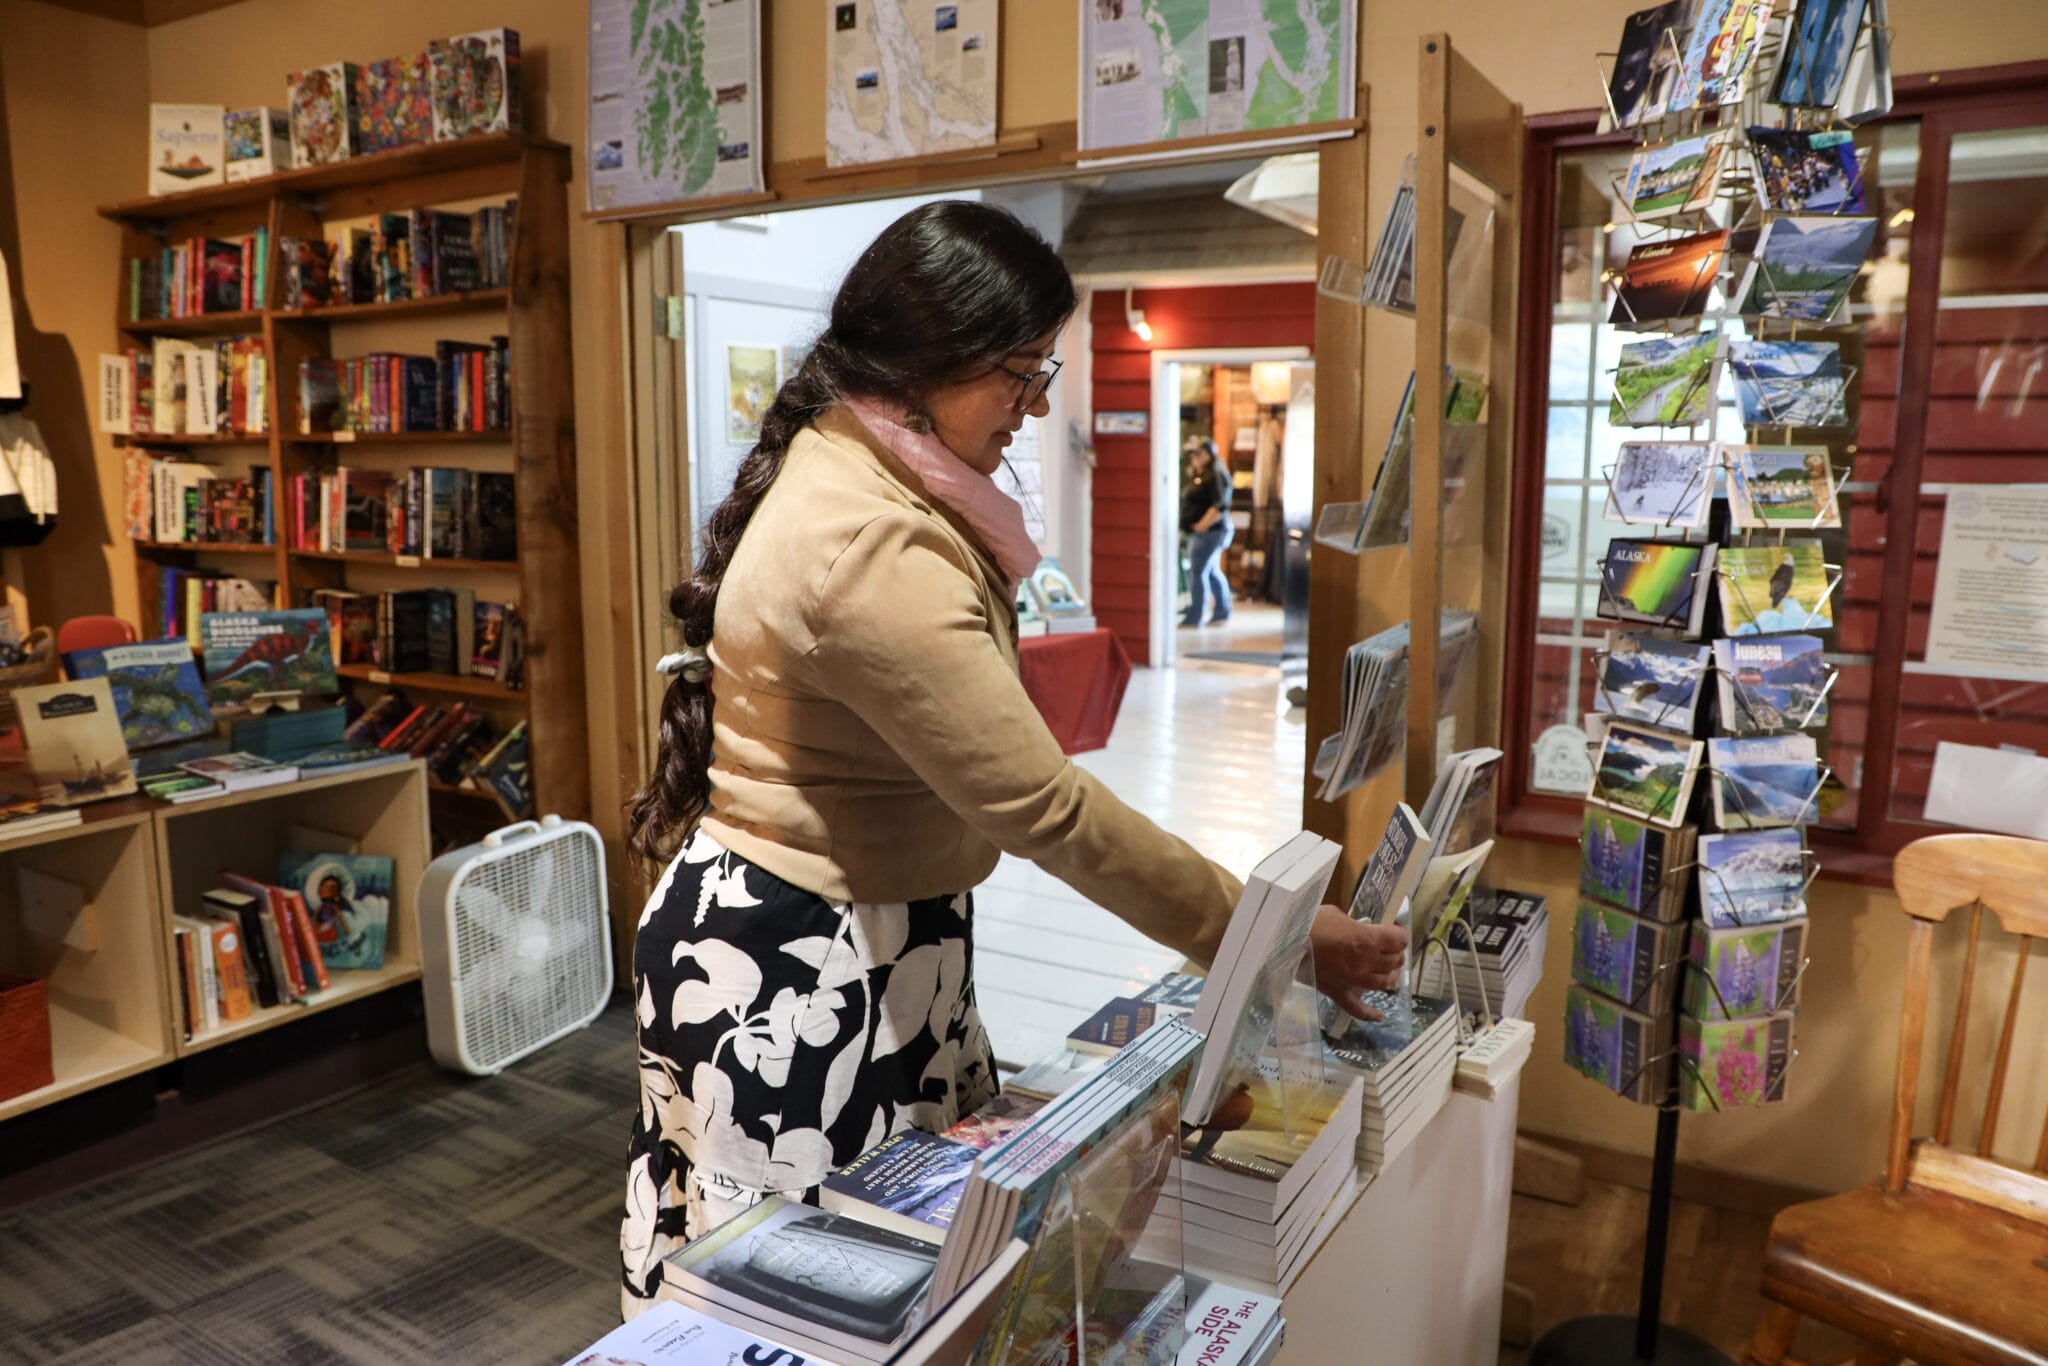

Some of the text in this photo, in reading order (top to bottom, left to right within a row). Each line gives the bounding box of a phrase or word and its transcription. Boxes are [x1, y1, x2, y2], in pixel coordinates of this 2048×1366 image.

[1614, 549, 1651, 563] ALASKA
[1735, 643, 1782, 660] Juneau
[1468, 1022, 1518, 1057] ALASKA
[839, 1135, 904, 1177] SPIKE WALKER
[896, 1143, 920, 1159] BECAME
[863, 1163, 889, 1181] LEGEND
[865, 1142, 935, 1191] ALASKAN RESCUE THAT
[883, 1157, 925, 1187] HARROWING
[897, 1167, 925, 1184] STORM,
[884, 1184, 900, 1197] AND
[1235, 1301, 1259, 1320] THE
[1194, 1305, 1230, 1338] SIDE
